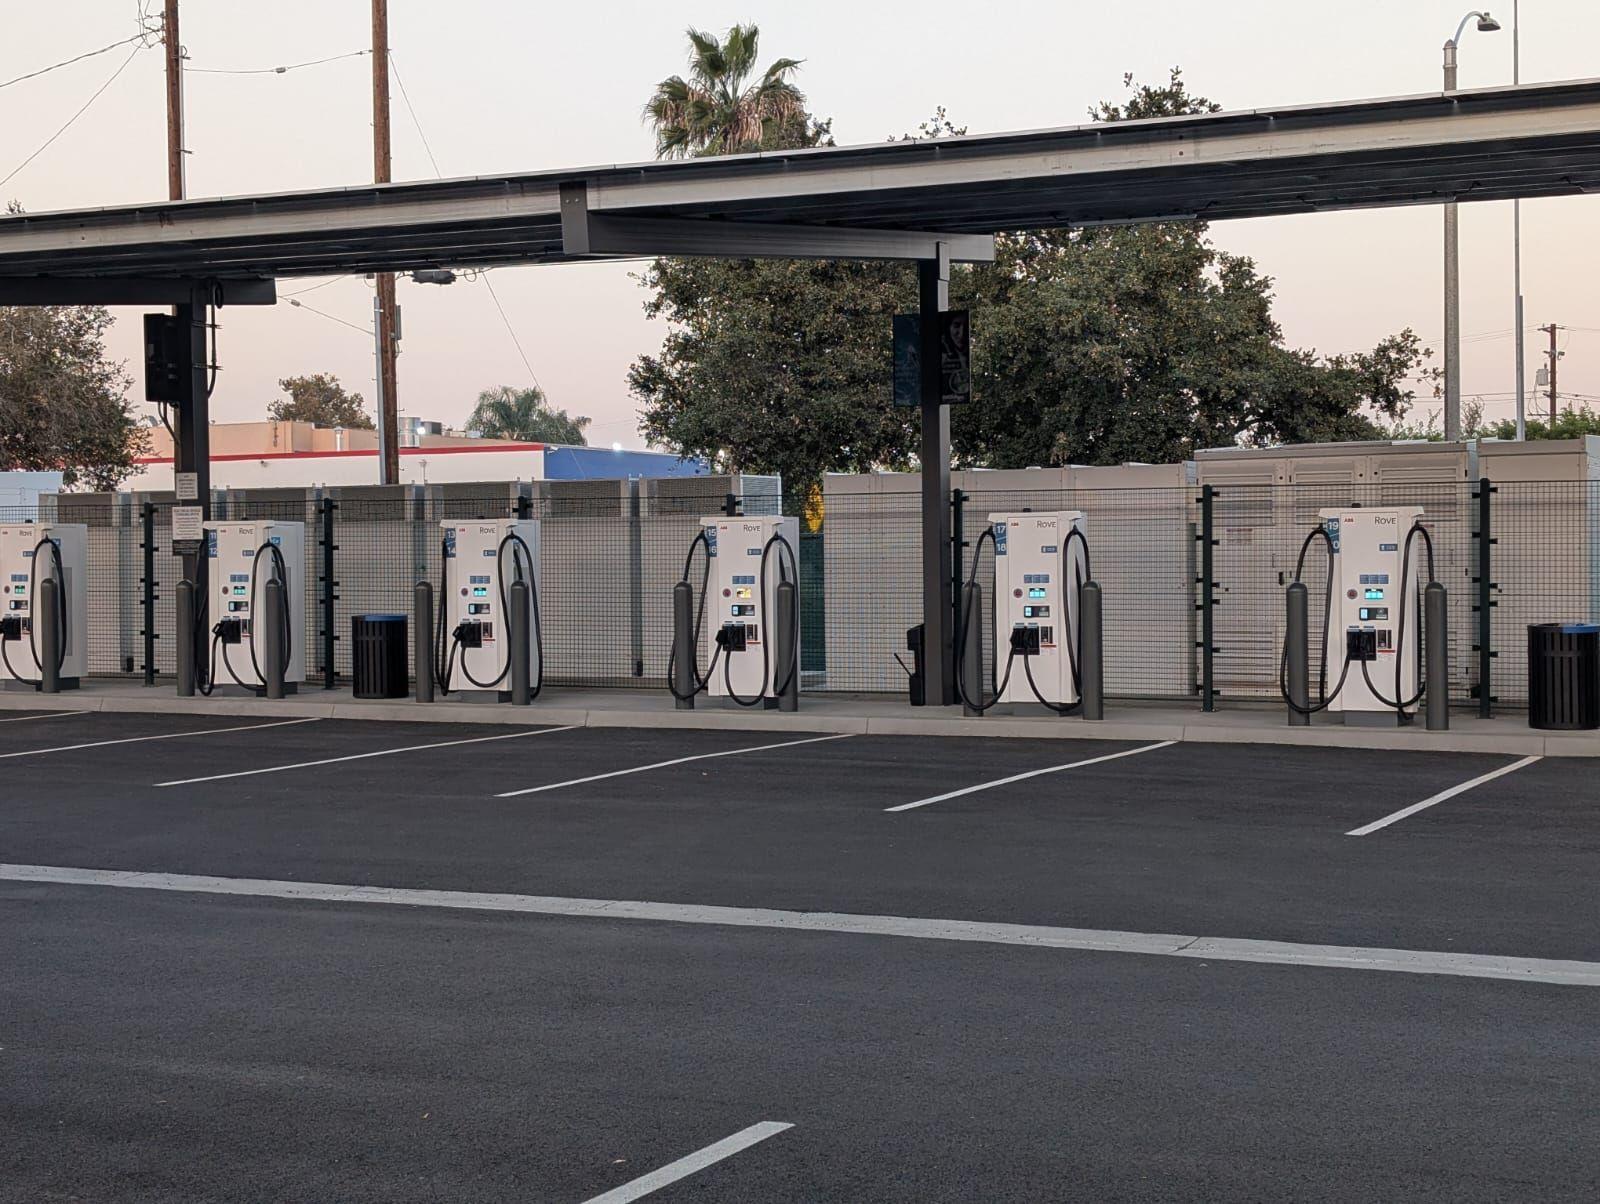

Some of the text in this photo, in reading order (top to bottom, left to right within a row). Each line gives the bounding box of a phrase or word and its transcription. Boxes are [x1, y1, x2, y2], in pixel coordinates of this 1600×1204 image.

[996, 525, 1006, 534] 17
[1328, 521, 1339, 530] 19
[447, 530, 456, 539] 13
[707, 528, 717, 537] 15
[997, 543, 1006, 552] 18
